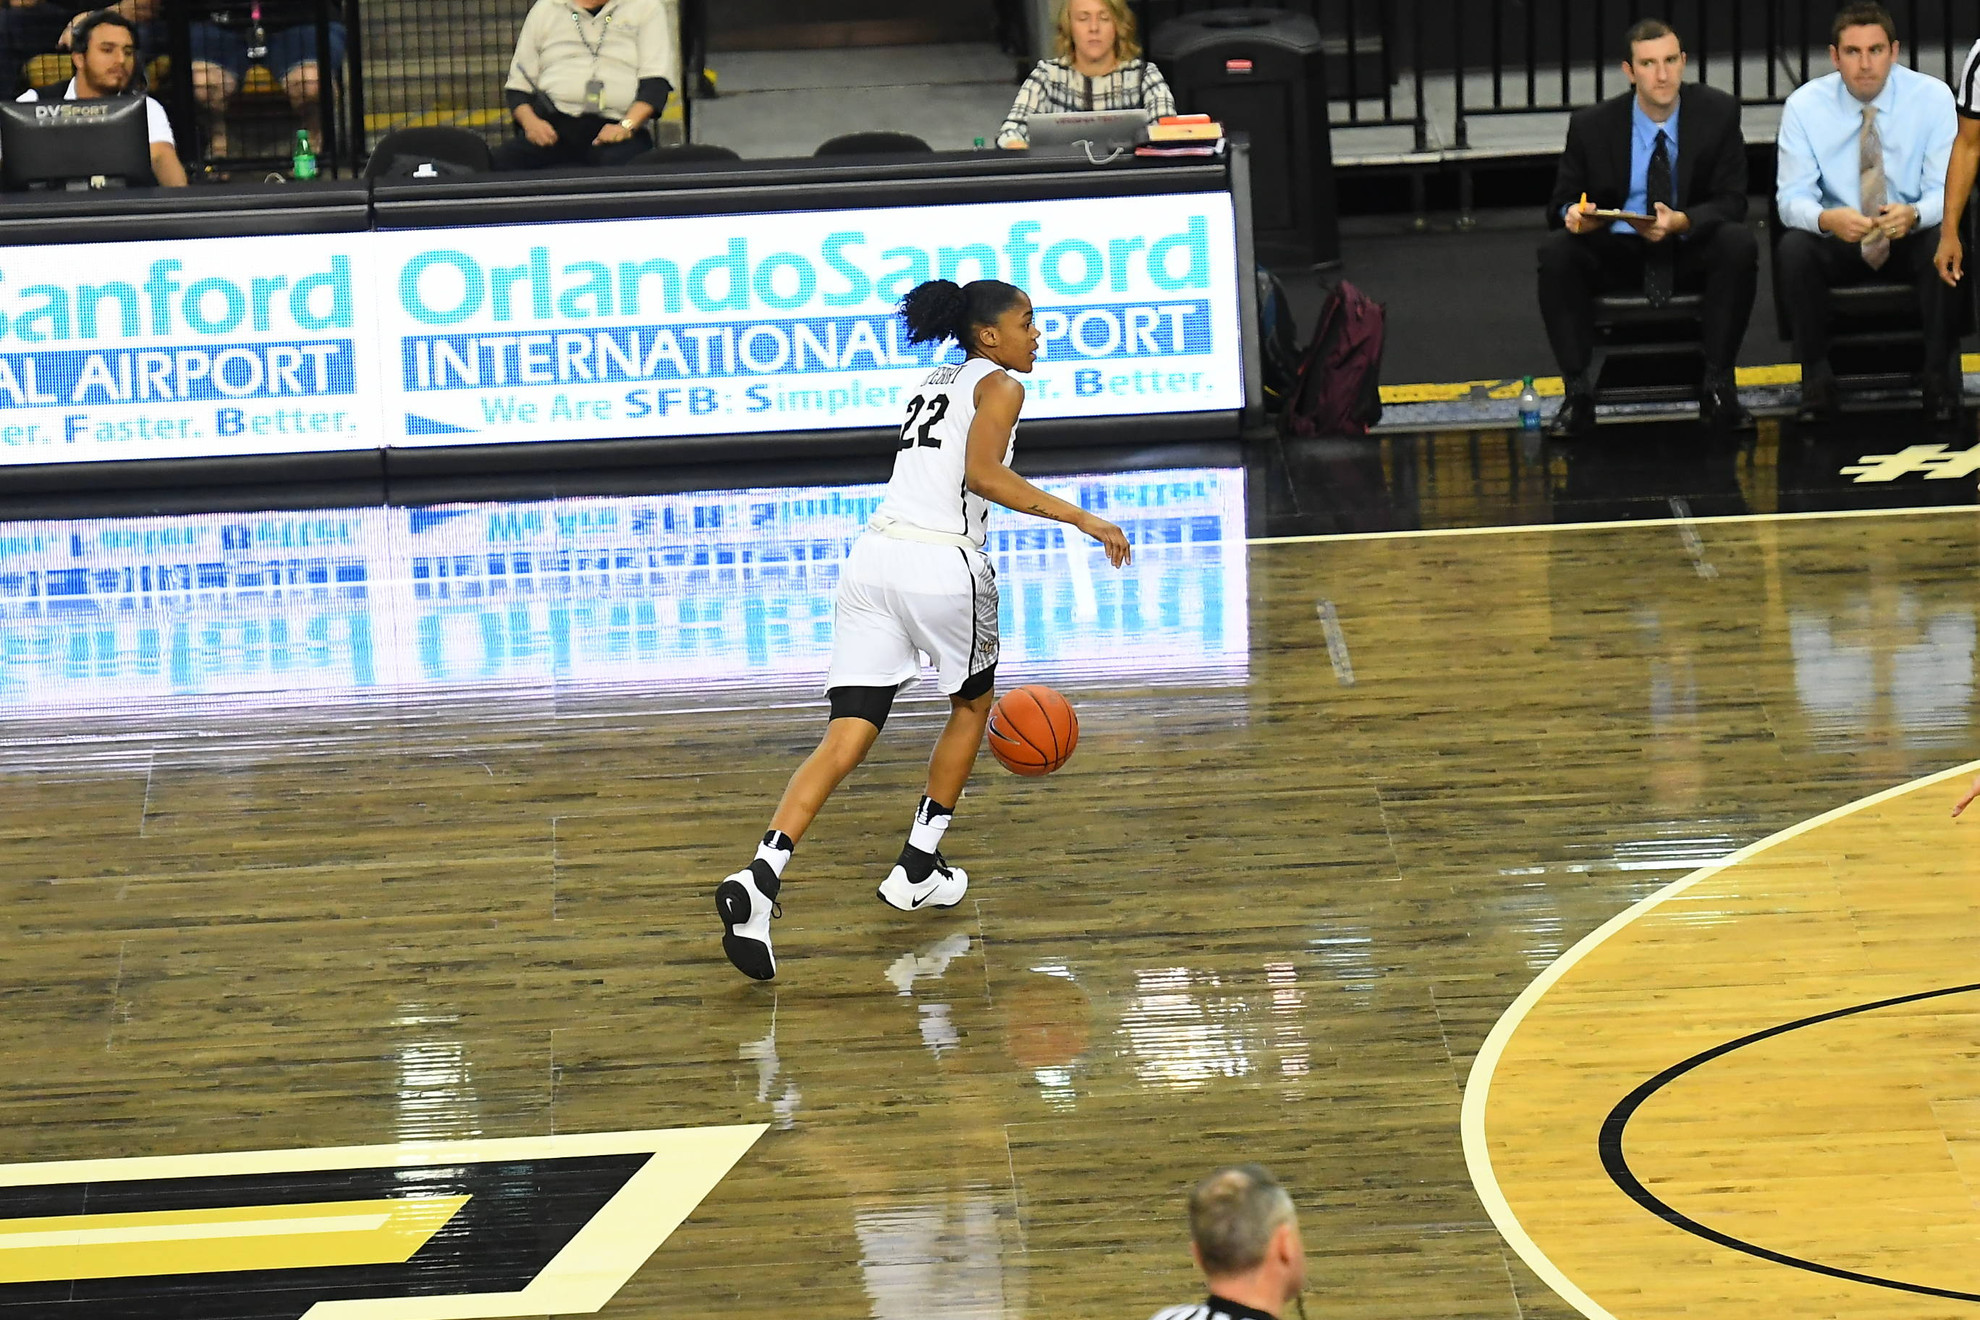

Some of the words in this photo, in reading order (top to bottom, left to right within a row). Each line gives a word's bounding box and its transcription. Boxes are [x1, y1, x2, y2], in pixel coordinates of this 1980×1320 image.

[0, 254, 353, 344] anford
[398, 215, 1211, 326] OrlandoSanford
[72, 344, 341, 402] AIRPORT
[415, 318, 919, 388] INTERNATIONAL
[64, 416, 205, 443] Faster.
[481, 395, 538, 425] We
[550, 393, 613, 422] Are
[899, 393, 950, 450] 22
